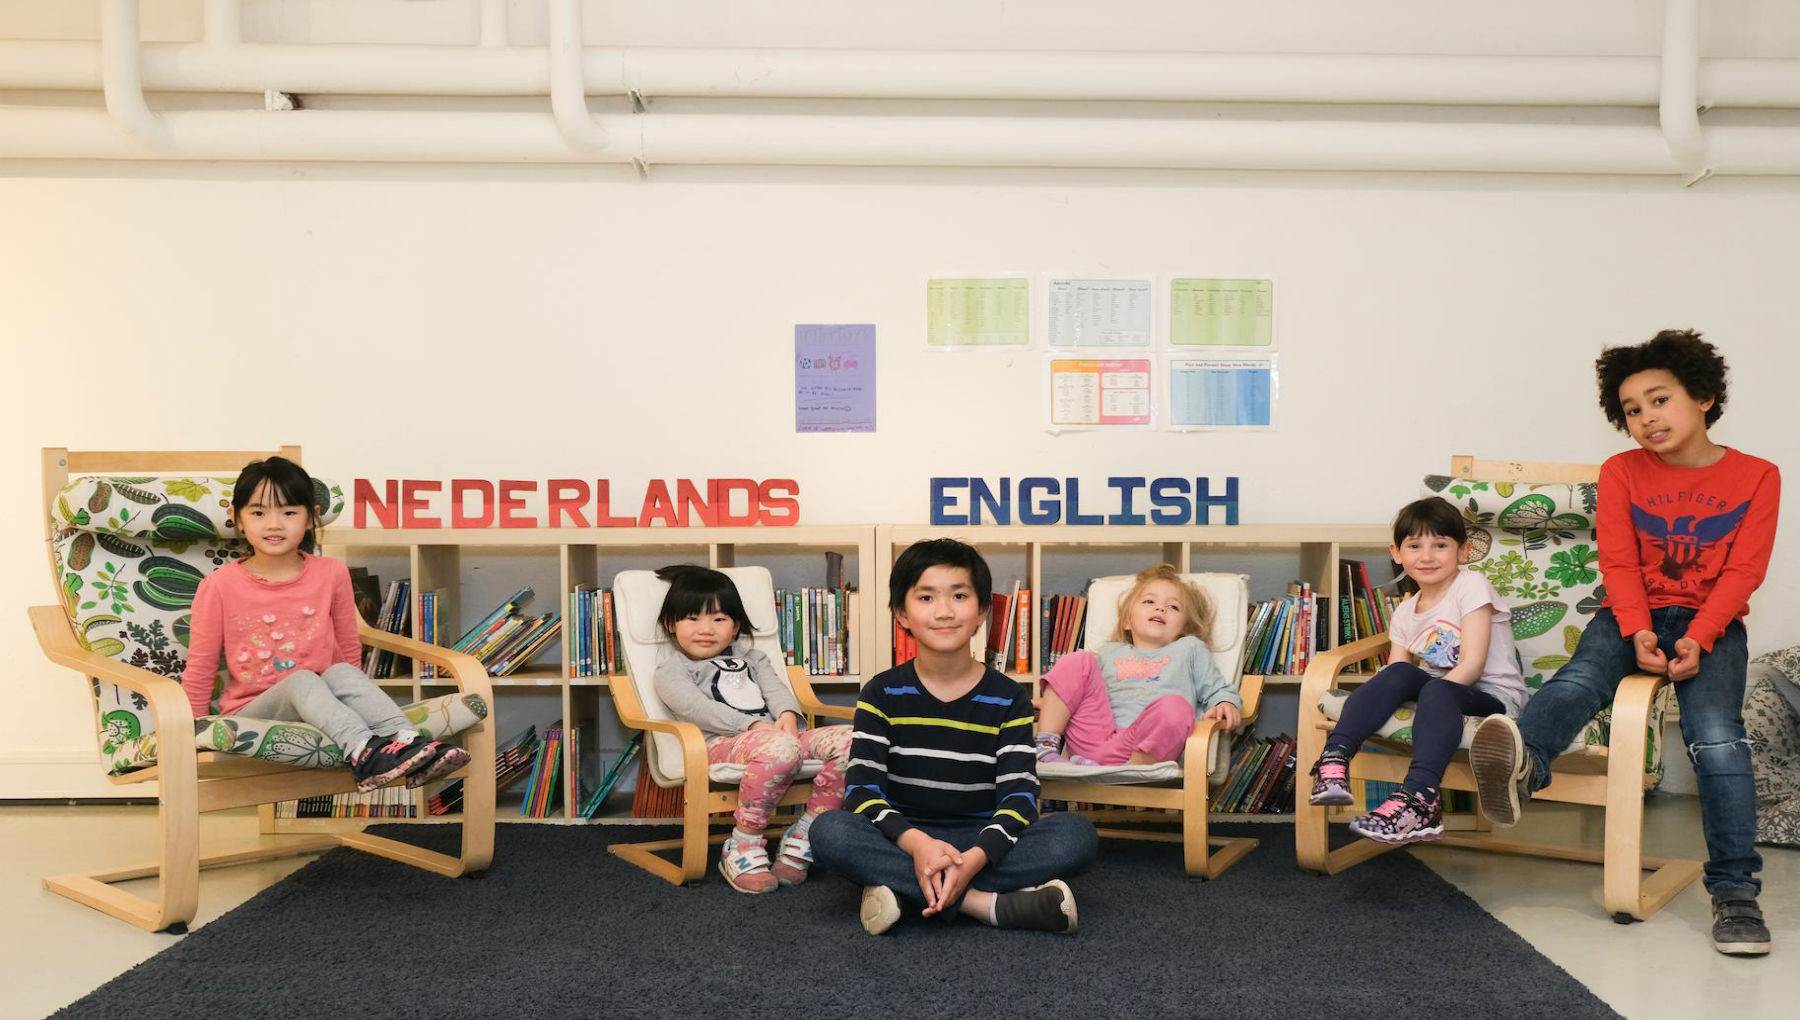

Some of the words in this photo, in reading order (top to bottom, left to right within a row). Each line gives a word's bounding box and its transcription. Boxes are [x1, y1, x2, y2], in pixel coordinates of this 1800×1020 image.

[354, 478, 799, 529] NEDERLANDS
[930, 477, 1239, 526] ENGLISH
[1646, 491, 1727, 510] HILFIGER
[735, 856, 751, 870] N
